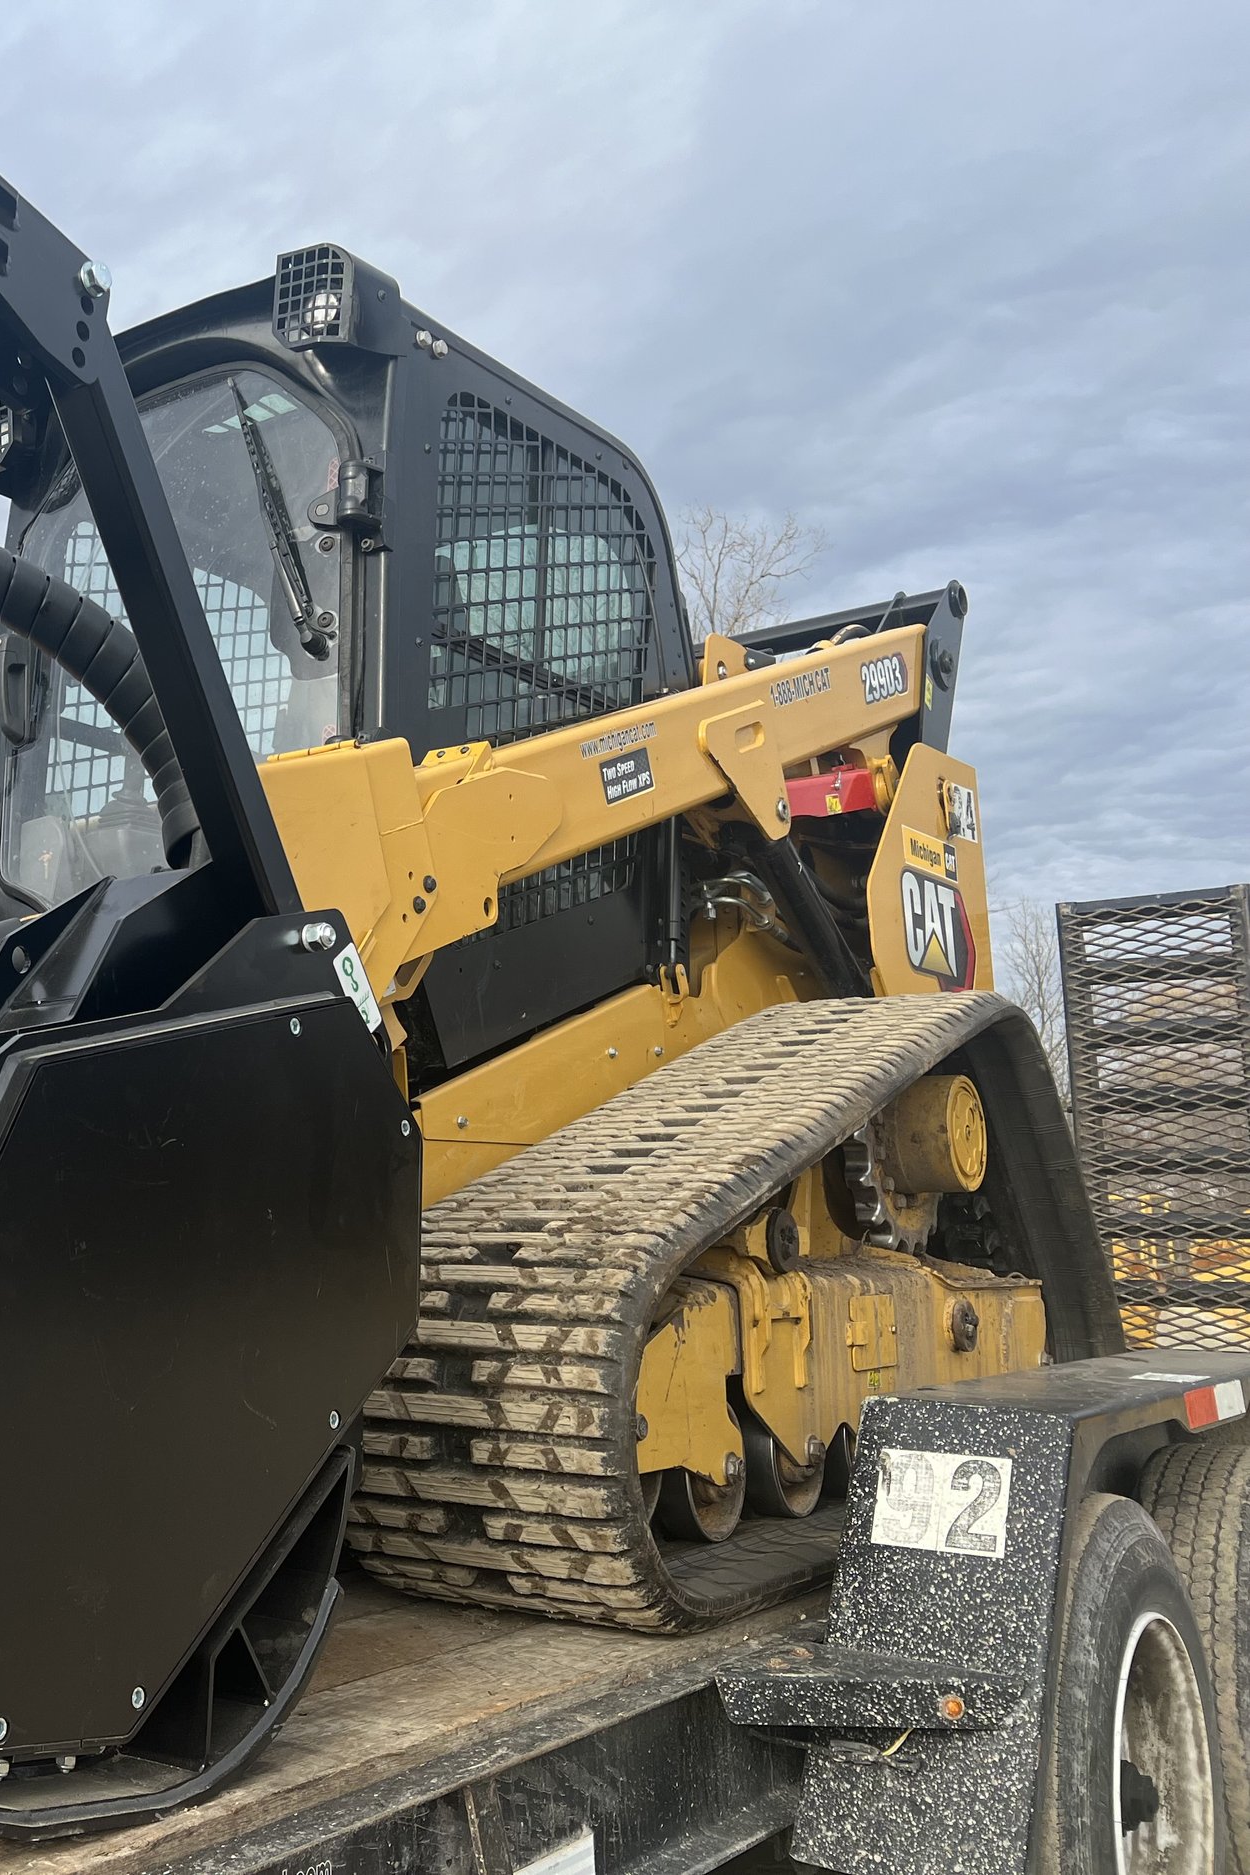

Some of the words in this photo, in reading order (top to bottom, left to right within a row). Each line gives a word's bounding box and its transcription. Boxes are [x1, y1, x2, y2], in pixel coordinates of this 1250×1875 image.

[770, 671, 815, 707] 1-888-MICH
[815, 667, 831, 694] CAT
[861, 656, 903, 703] 299D3
[579, 721, 657, 759] www.michigancat.com
[637, 771, 651, 788] XPS
[910, 837, 942, 867] Michigan
[901, 871, 958, 978] CAT
